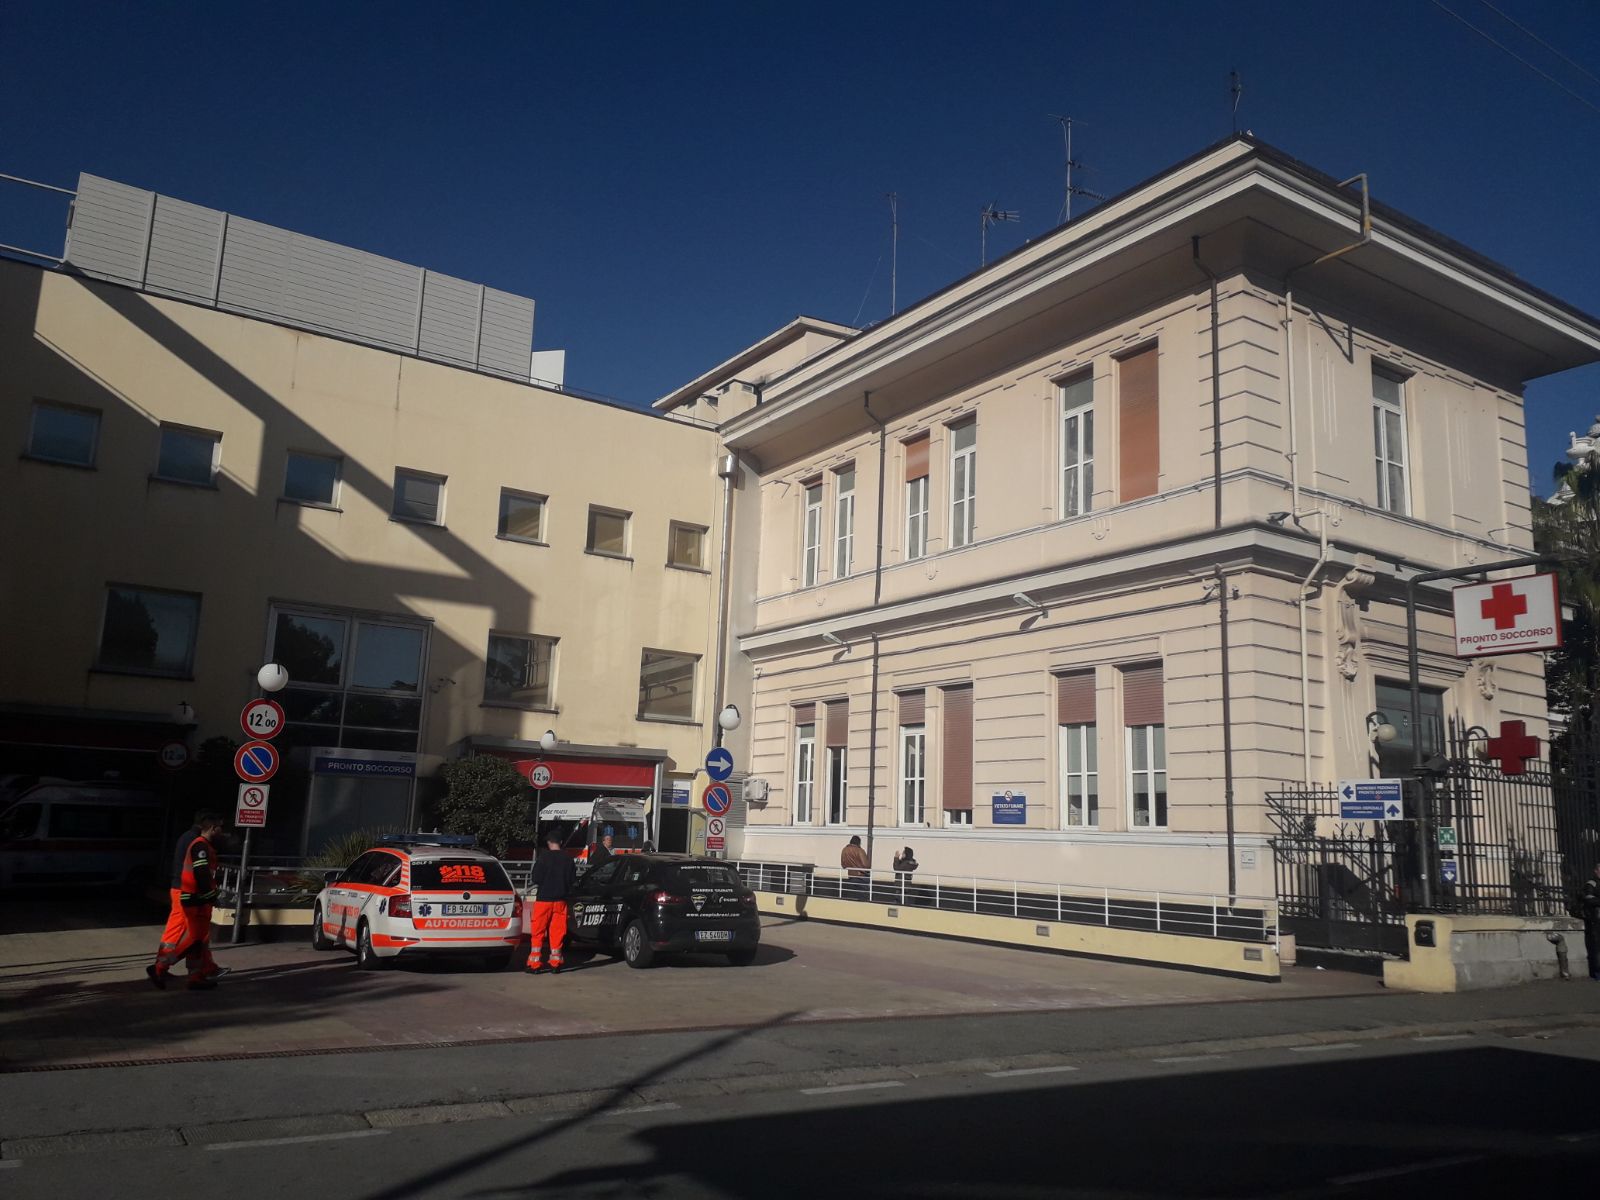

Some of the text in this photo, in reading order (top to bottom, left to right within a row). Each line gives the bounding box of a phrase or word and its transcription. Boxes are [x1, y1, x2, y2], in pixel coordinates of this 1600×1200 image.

[1460, 627, 1553, 645] PRONTO SOCCORSO
[327, 761, 412, 774] PRONTO SOCCORSO
[453, 864, 486, 878] 118
[424, 919, 499, 928] AUTOMEDICA
